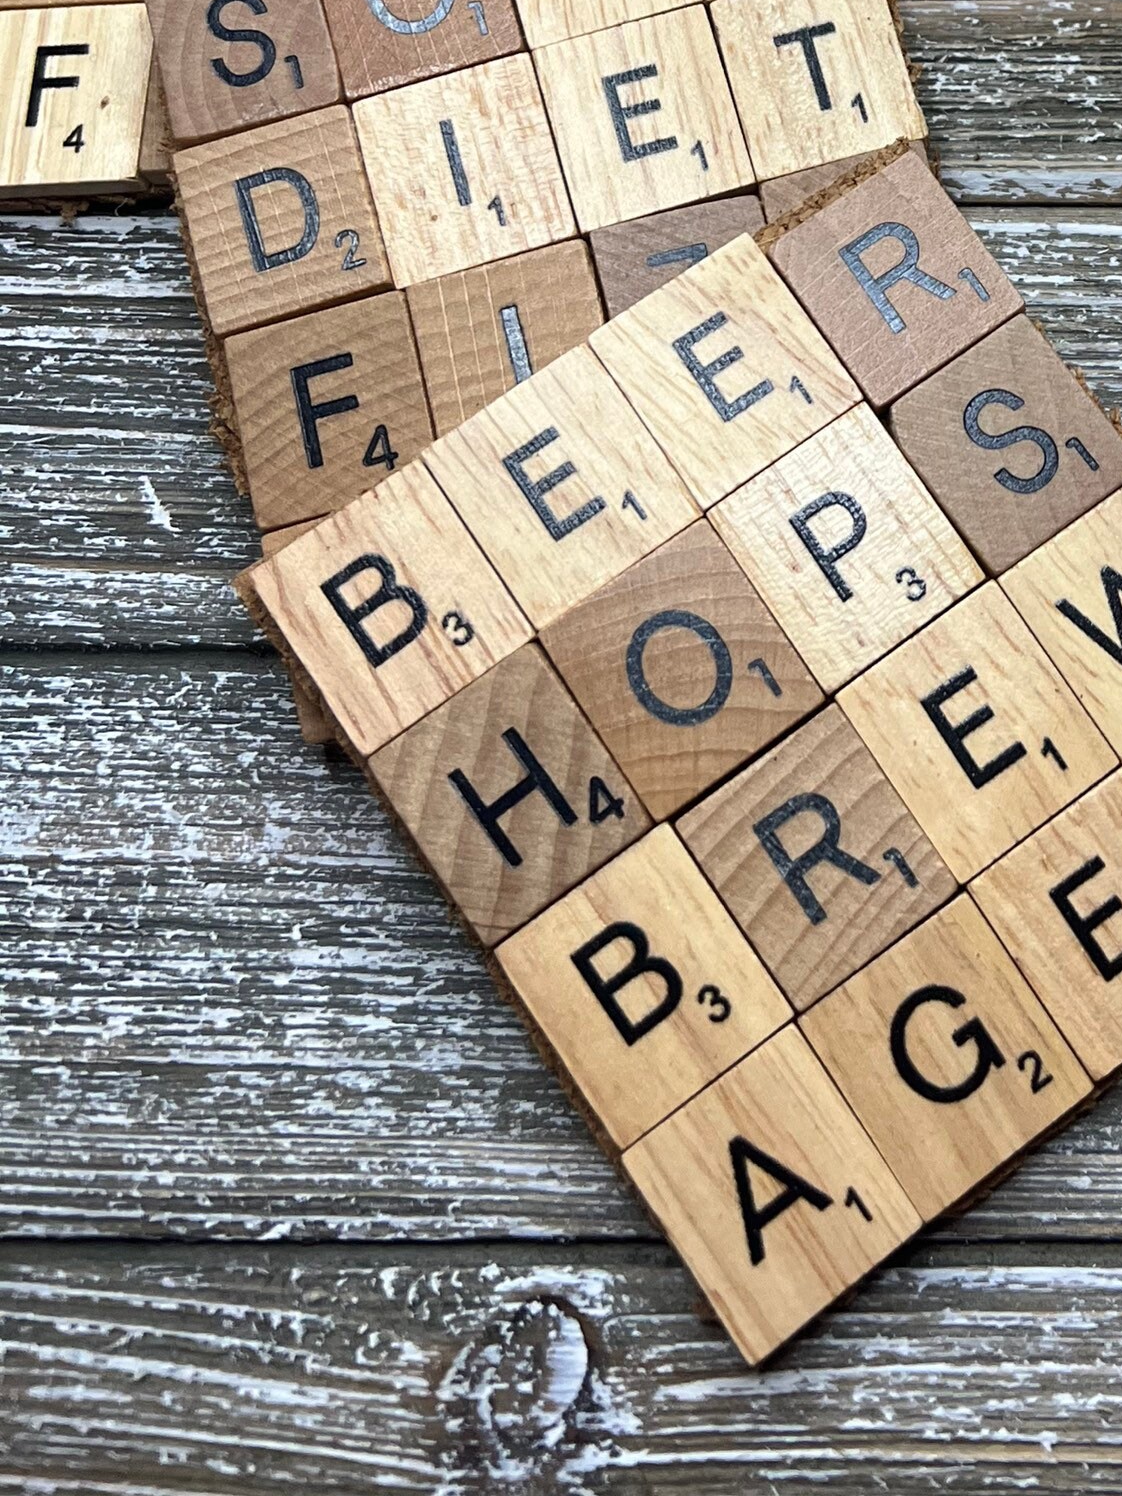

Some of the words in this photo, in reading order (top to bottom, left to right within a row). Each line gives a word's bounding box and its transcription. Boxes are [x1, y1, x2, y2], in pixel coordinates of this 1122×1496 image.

[62, 125, 85, 153] 4
[235, 22, 835, 271] DIET
[285, 55, 304, 90] 1
[467, 0, 489, 34] 1
[334, 229, 367, 271] 2
[487, 196, 507, 226] 1
[690, 140, 710, 171] 1
[850, 94, 869, 122] 1
[319, 221, 956, 667] BEER
[364, 425, 399, 470] 4
[442, 610, 476, 647] 3
[621, 489, 648, 522] 1
[790, 374, 815, 405] 1
[960, 266, 993, 301] 1
[447, 389, 1060, 865] HOPS
[585, 778, 626, 824] 4
[749, 657, 783, 698] 1
[894, 567, 927, 601] 3
[1067, 434, 1099, 471] 1
[697, 984, 733, 1023] 3
[881, 844, 922, 890] 1
[1040, 736, 1067, 772] 1
[844, 1187, 873, 1224] 1
[1017, 1049, 1052, 1093] 2
